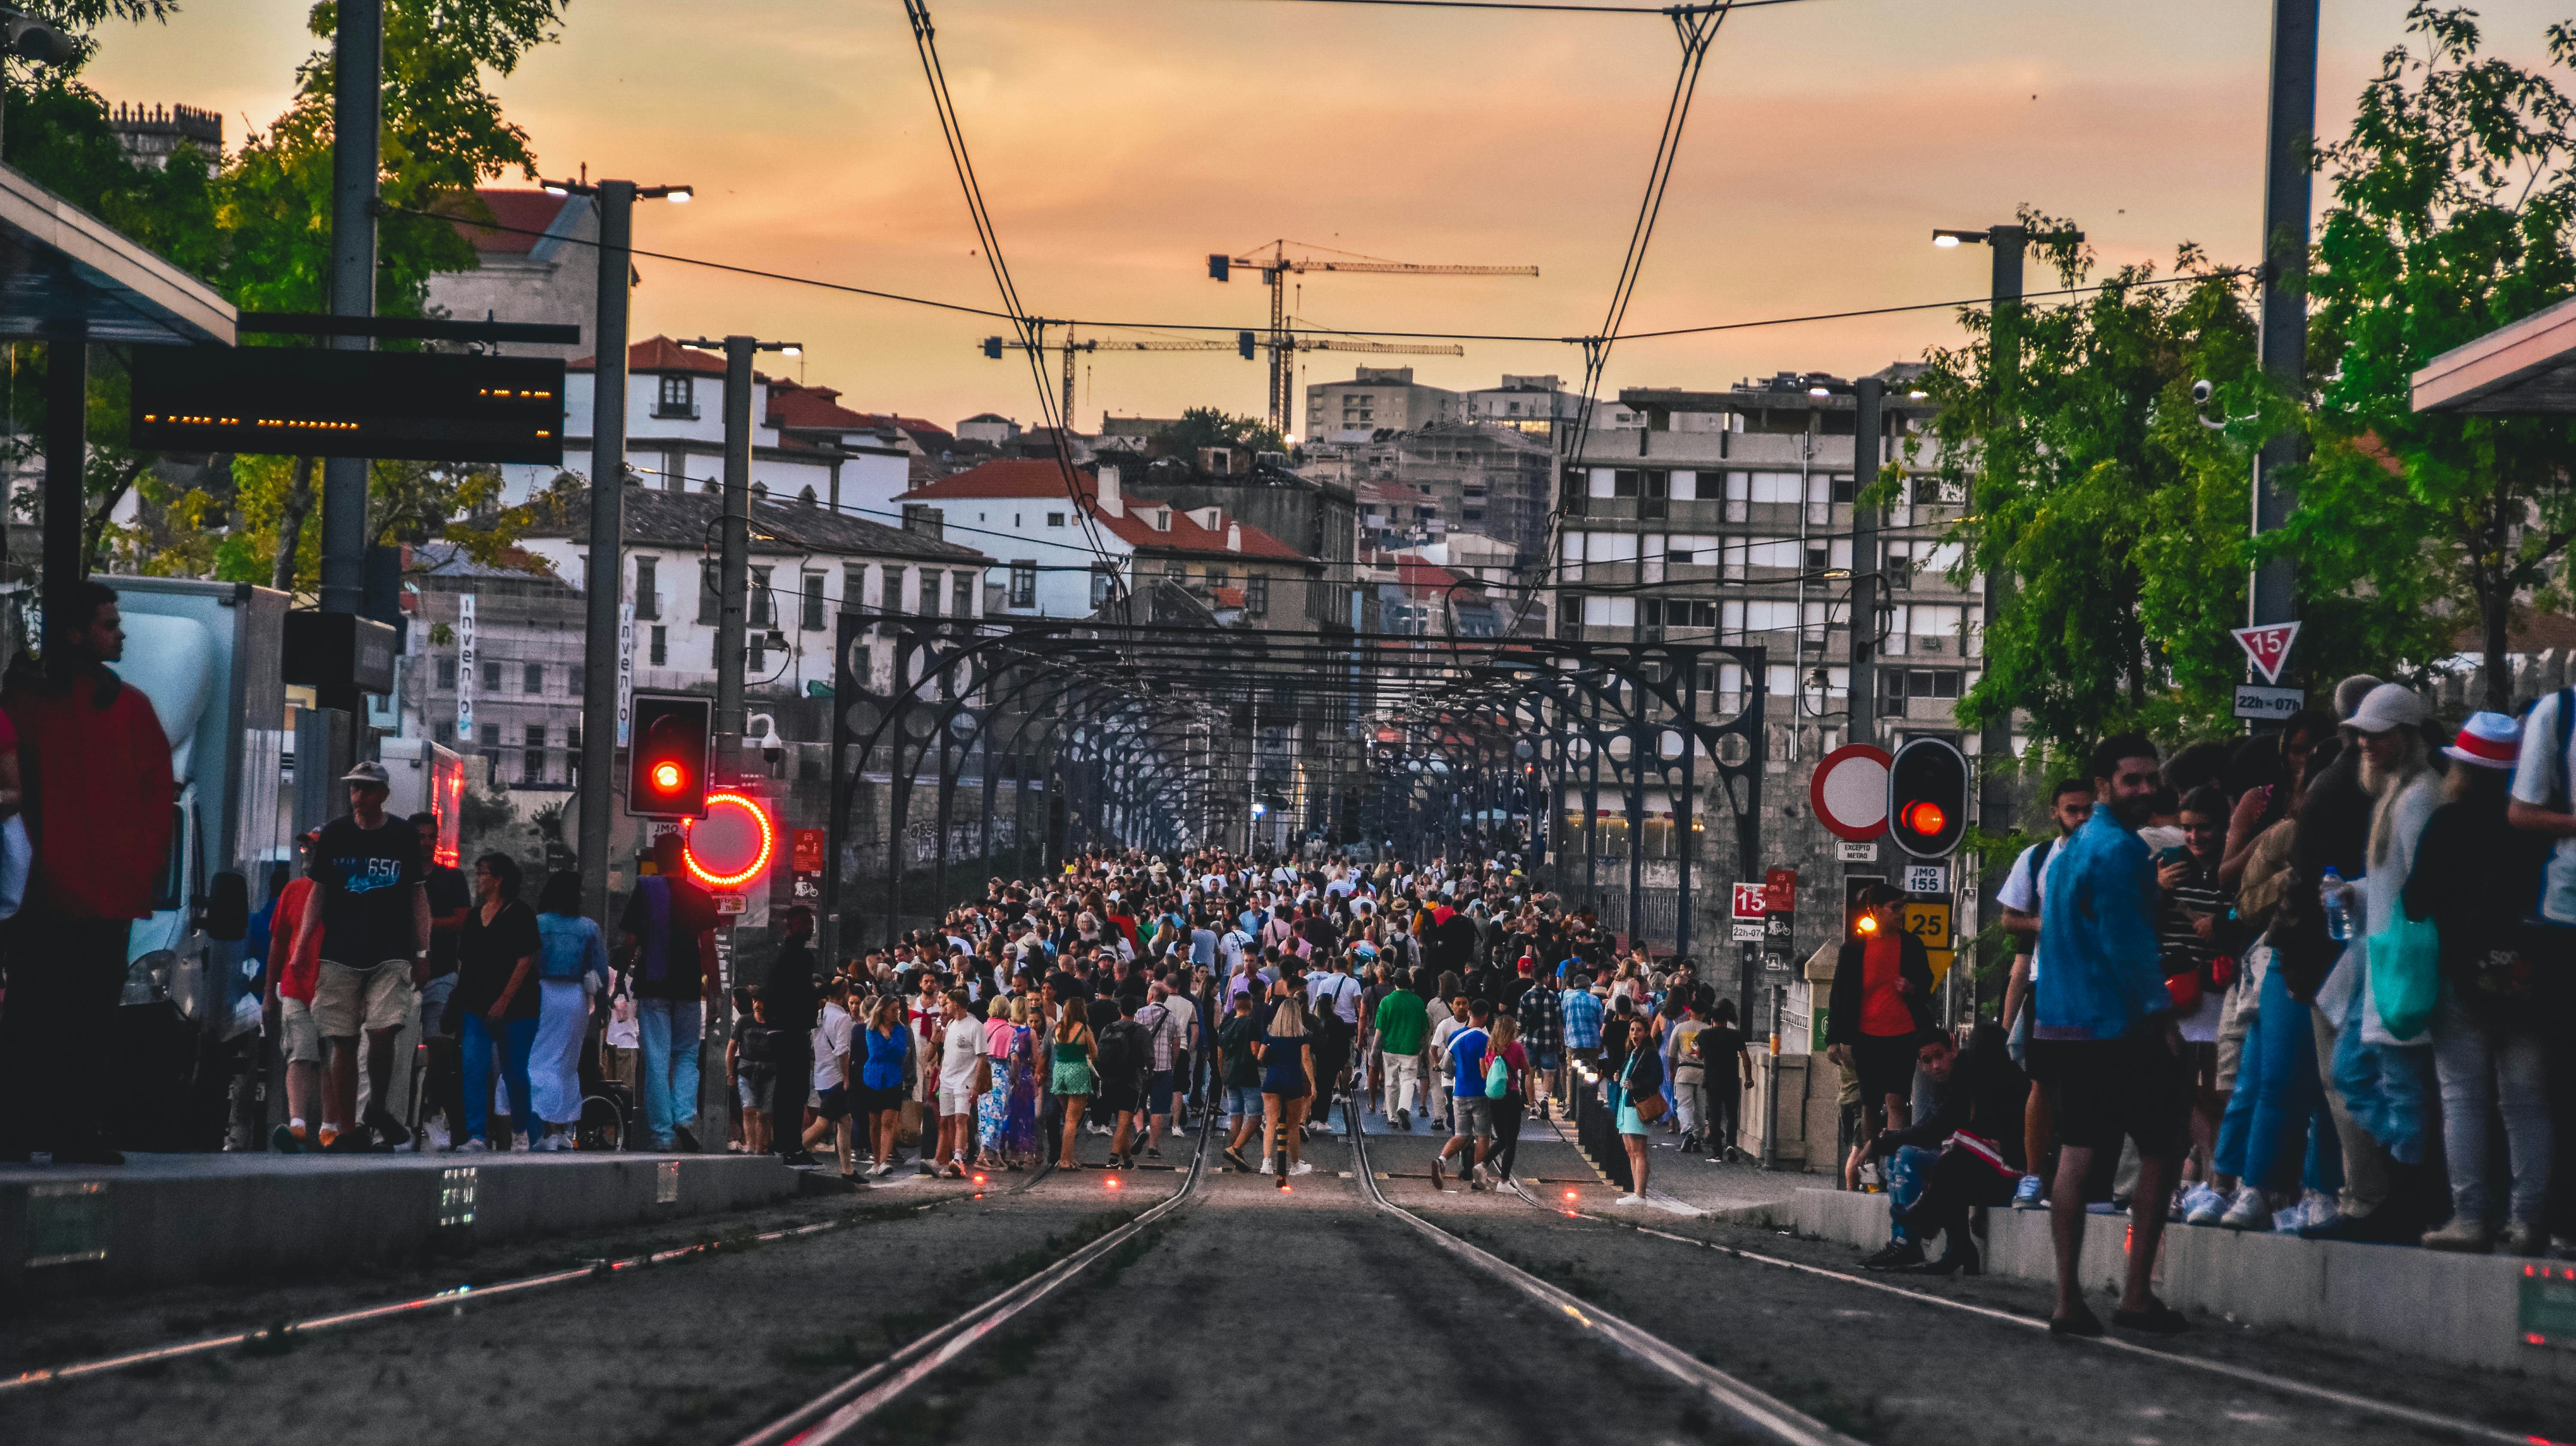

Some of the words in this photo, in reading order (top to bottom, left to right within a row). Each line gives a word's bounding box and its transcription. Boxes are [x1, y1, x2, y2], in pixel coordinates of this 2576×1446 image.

[2252, 630, 2282, 655] 15
[655, 824, 678, 832] JMO
[368, 857, 401, 881] 650
[1914, 868, 1937, 877] JMO
[1911, 878, 1938, 891] 155
[1738, 892, 1764, 911] 15
[1912, 914, 1941, 936] 25
